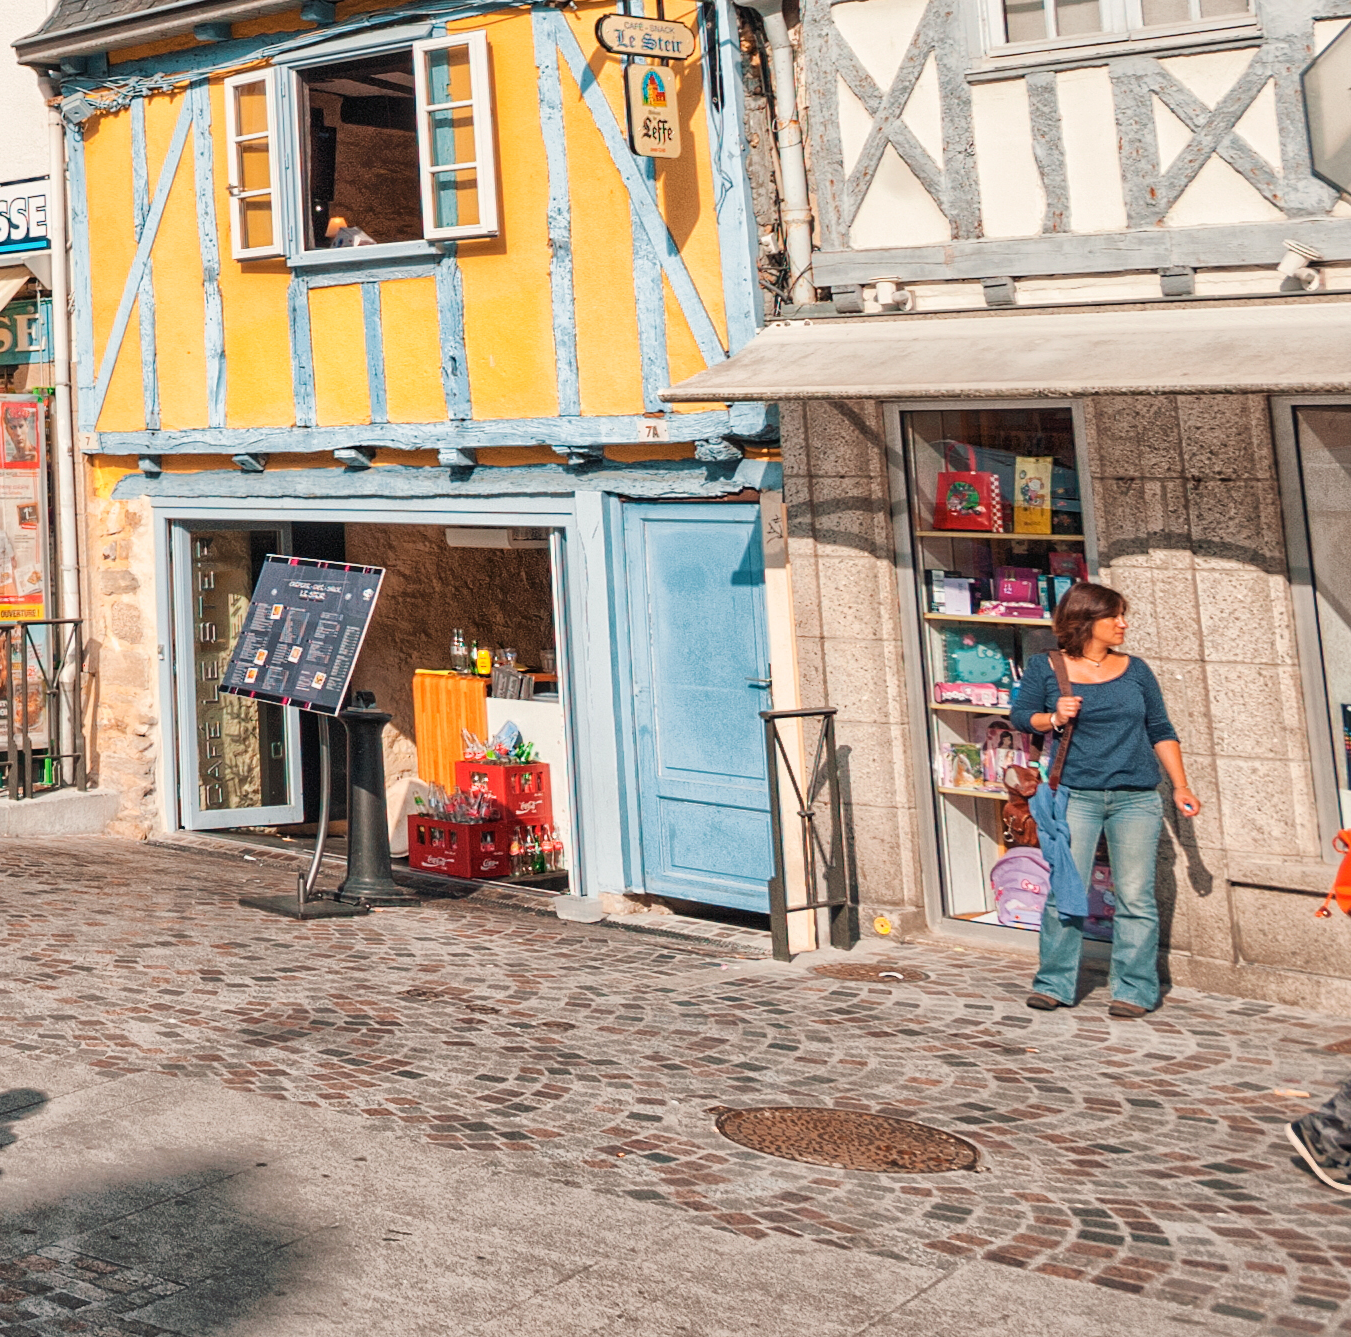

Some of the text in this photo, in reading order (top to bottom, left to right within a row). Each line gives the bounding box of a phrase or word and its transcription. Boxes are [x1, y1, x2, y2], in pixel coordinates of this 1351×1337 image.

[650, 24, 676, 34] SNACK
[614, 29, 683, 53] Le Steir
[642, 117, 674, 144] Leffe
[85, 436, 91, 446] 7
